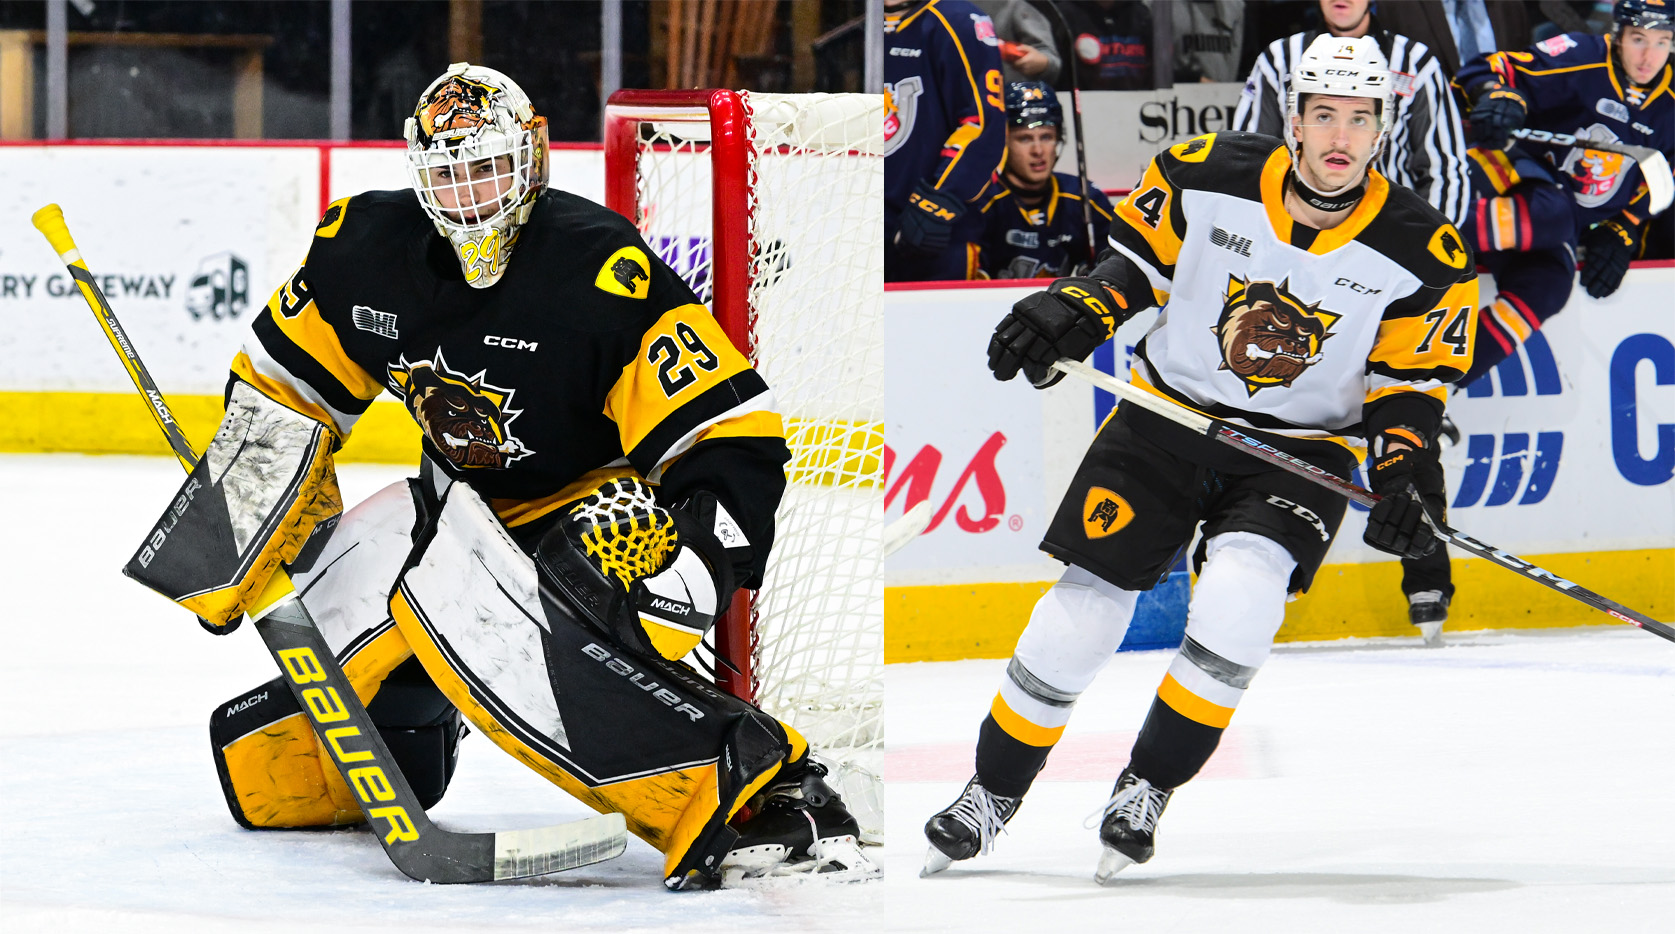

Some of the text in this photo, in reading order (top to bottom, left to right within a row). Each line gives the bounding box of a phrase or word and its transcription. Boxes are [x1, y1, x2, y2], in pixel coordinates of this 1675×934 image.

[890, 47, 922, 57] CCM
[1325, 69, 1360, 77] CCM
[909, 193, 956, 221] CCM
[459, 228, 500, 284] 29
[1209, 225, 1253, 257] OHL
[46, 274, 176, 298] GAEWAY
[278, 265, 314, 320] 9
[1334, 277, 1382, 296] CCM
[352, 305, 398, 340] OHL
[1061, 285, 1115, 341] CCM
[483, 335, 539, 352] CCM
[1415, 305, 1474, 357] 74
[647, 321, 719, 400] 29
[146, 389, 174, 424] MACH
[1220, 426, 1328, 475] TSPEED
[1376, 454, 1404, 471] CCM
[138, 477, 203, 569] BAUER
[1265, 494, 1331, 543] CCM
[1452, 531, 1578, 591] CCM
[651, 598, 691, 617] MACH
[1608, 609, 1643, 627] CCM
[581, 641, 706, 724] BAUER
[226, 691, 269, 719] MACH
[277, 645, 421, 847] BAUER
